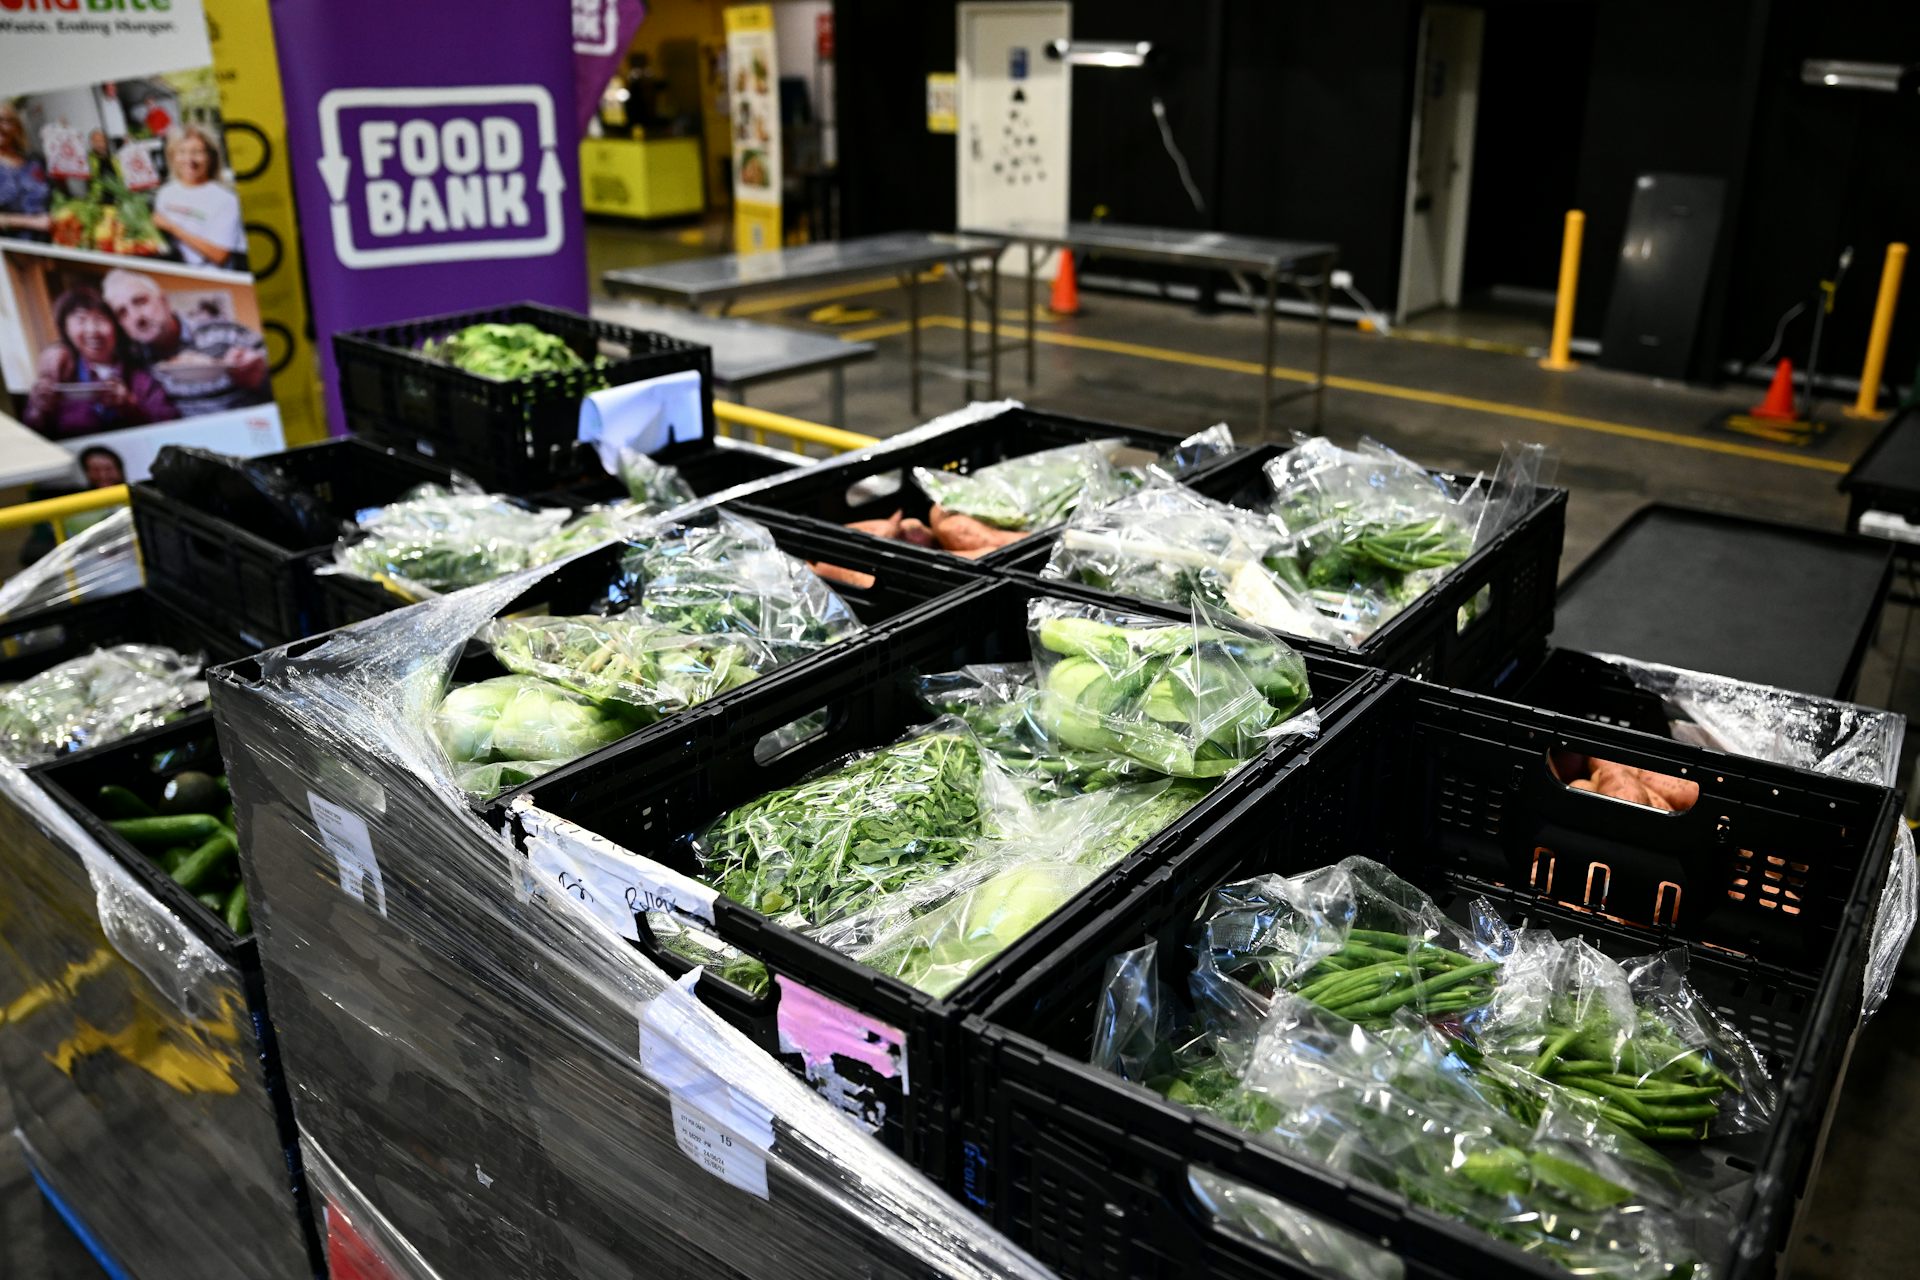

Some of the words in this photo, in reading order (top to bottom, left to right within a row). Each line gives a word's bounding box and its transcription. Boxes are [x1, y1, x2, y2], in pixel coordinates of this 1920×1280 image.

[359, 117, 523, 178] FOOD
[366, 171, 531, 237] BANK
[720, 1134, 732, 1148] 15
